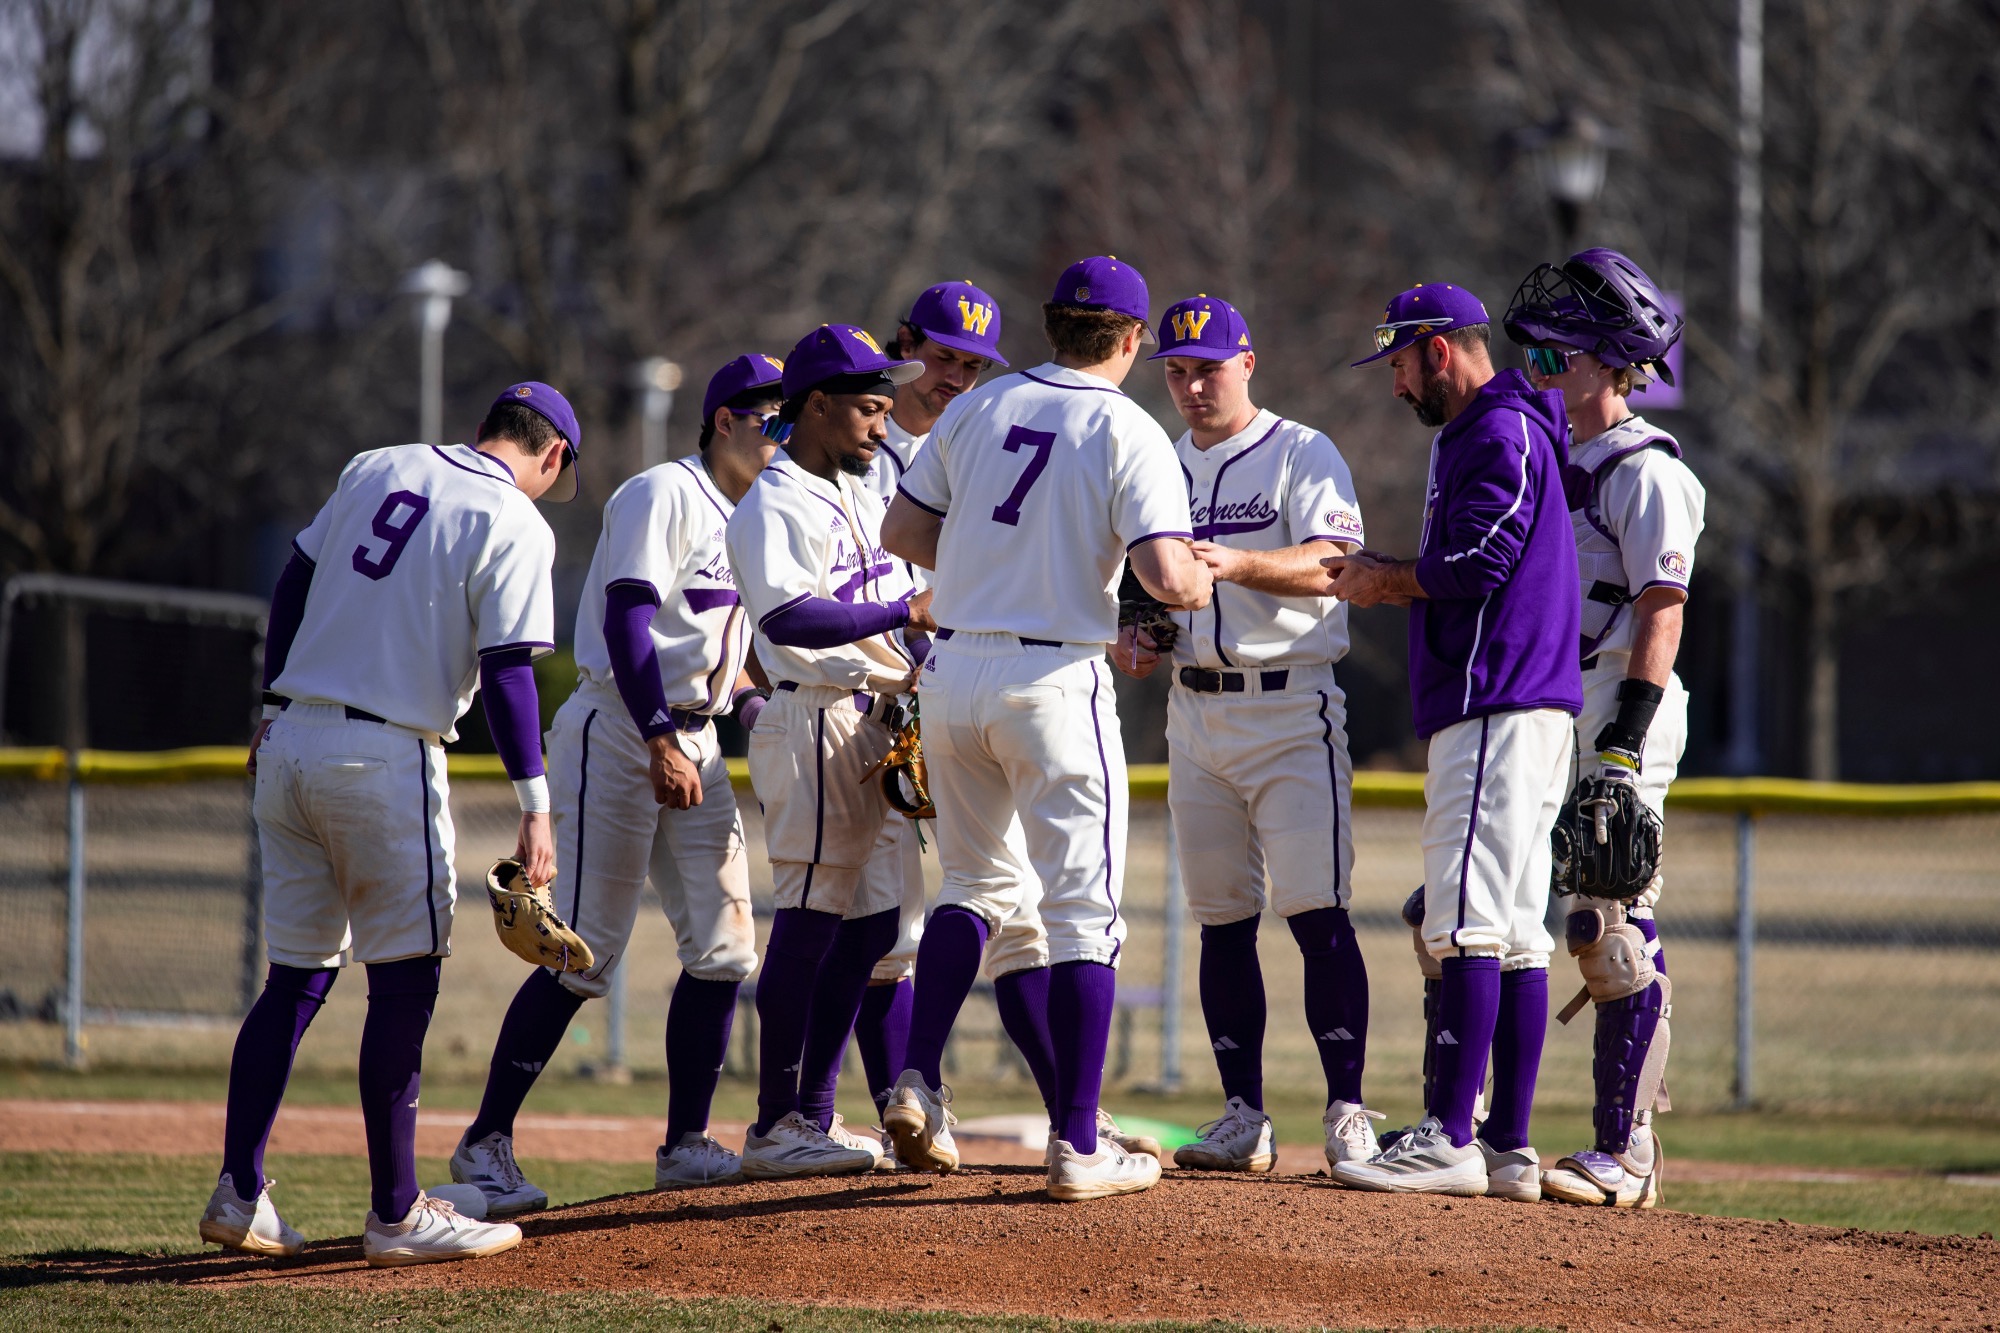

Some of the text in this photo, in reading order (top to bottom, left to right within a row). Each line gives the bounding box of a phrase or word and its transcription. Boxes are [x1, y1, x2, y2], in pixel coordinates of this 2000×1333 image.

[958, 300, 993, 337] W
[1172, 310, 1212, 342] W
[1640, 313, 1660, 339] EASTON
[991, 424, 1057, 527] 7
[1189, 492, 1271, 524] hernecks
[1333, 515, 1360, 532] OVC
[352, 489, 430, 582] 9
